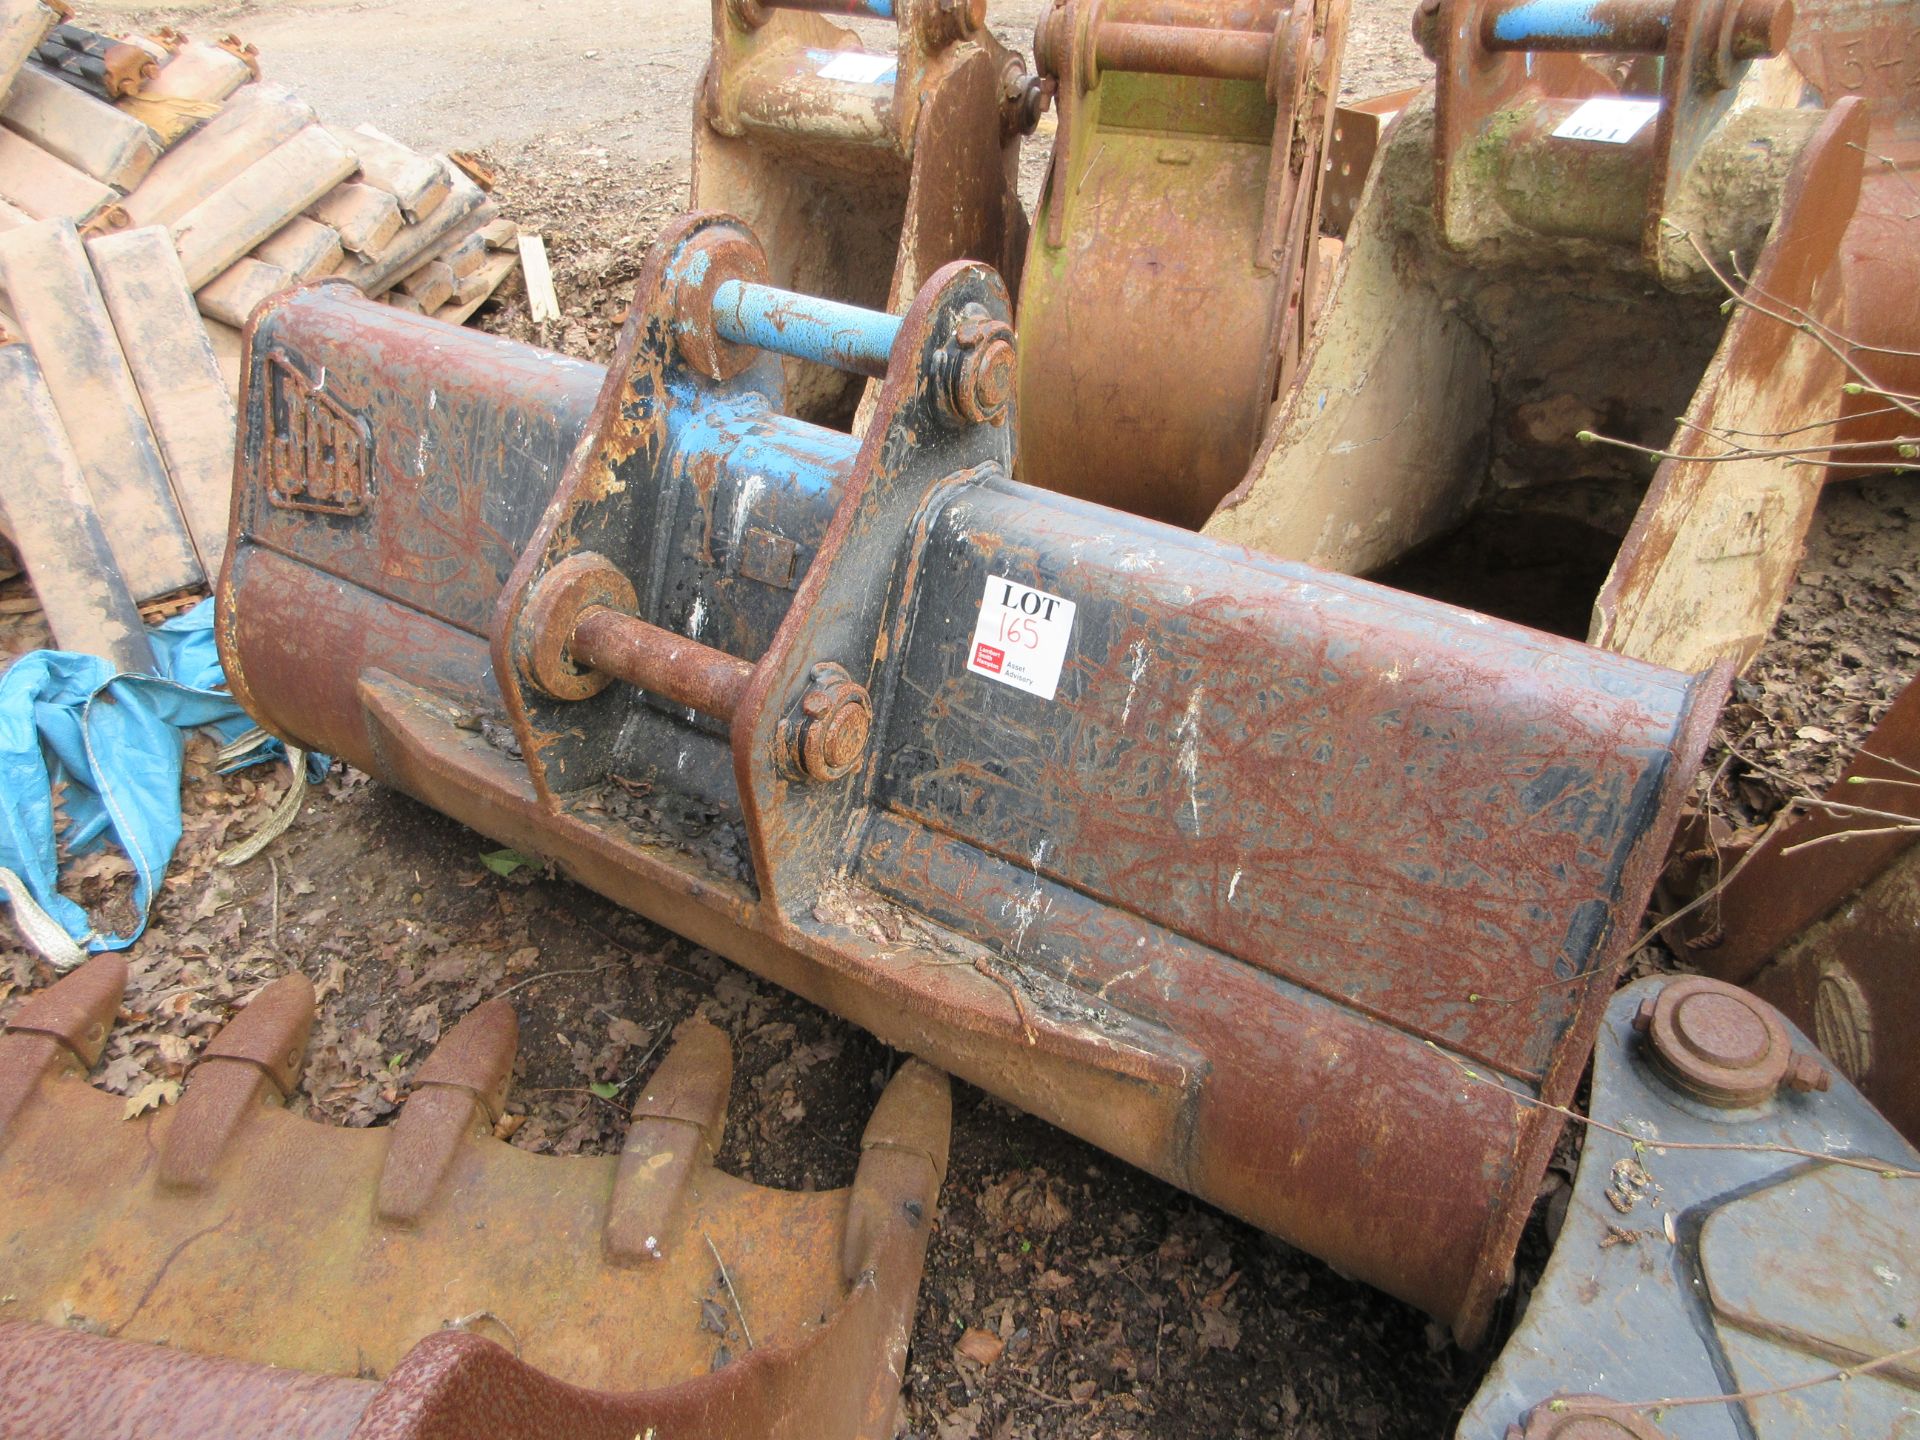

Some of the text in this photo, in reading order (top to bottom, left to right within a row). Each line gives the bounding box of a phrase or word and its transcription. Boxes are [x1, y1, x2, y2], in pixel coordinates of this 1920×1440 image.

[1001, 584, 1060, 621] LOT
[999, 612, 1038, 649] 165
[979, 646, 1000, 658] Lambert
[976, 657, 1000, 670] Hampton
[1006, 660, 1026, 673] Asset
[1005, 670, 1033, 685] Advisory
